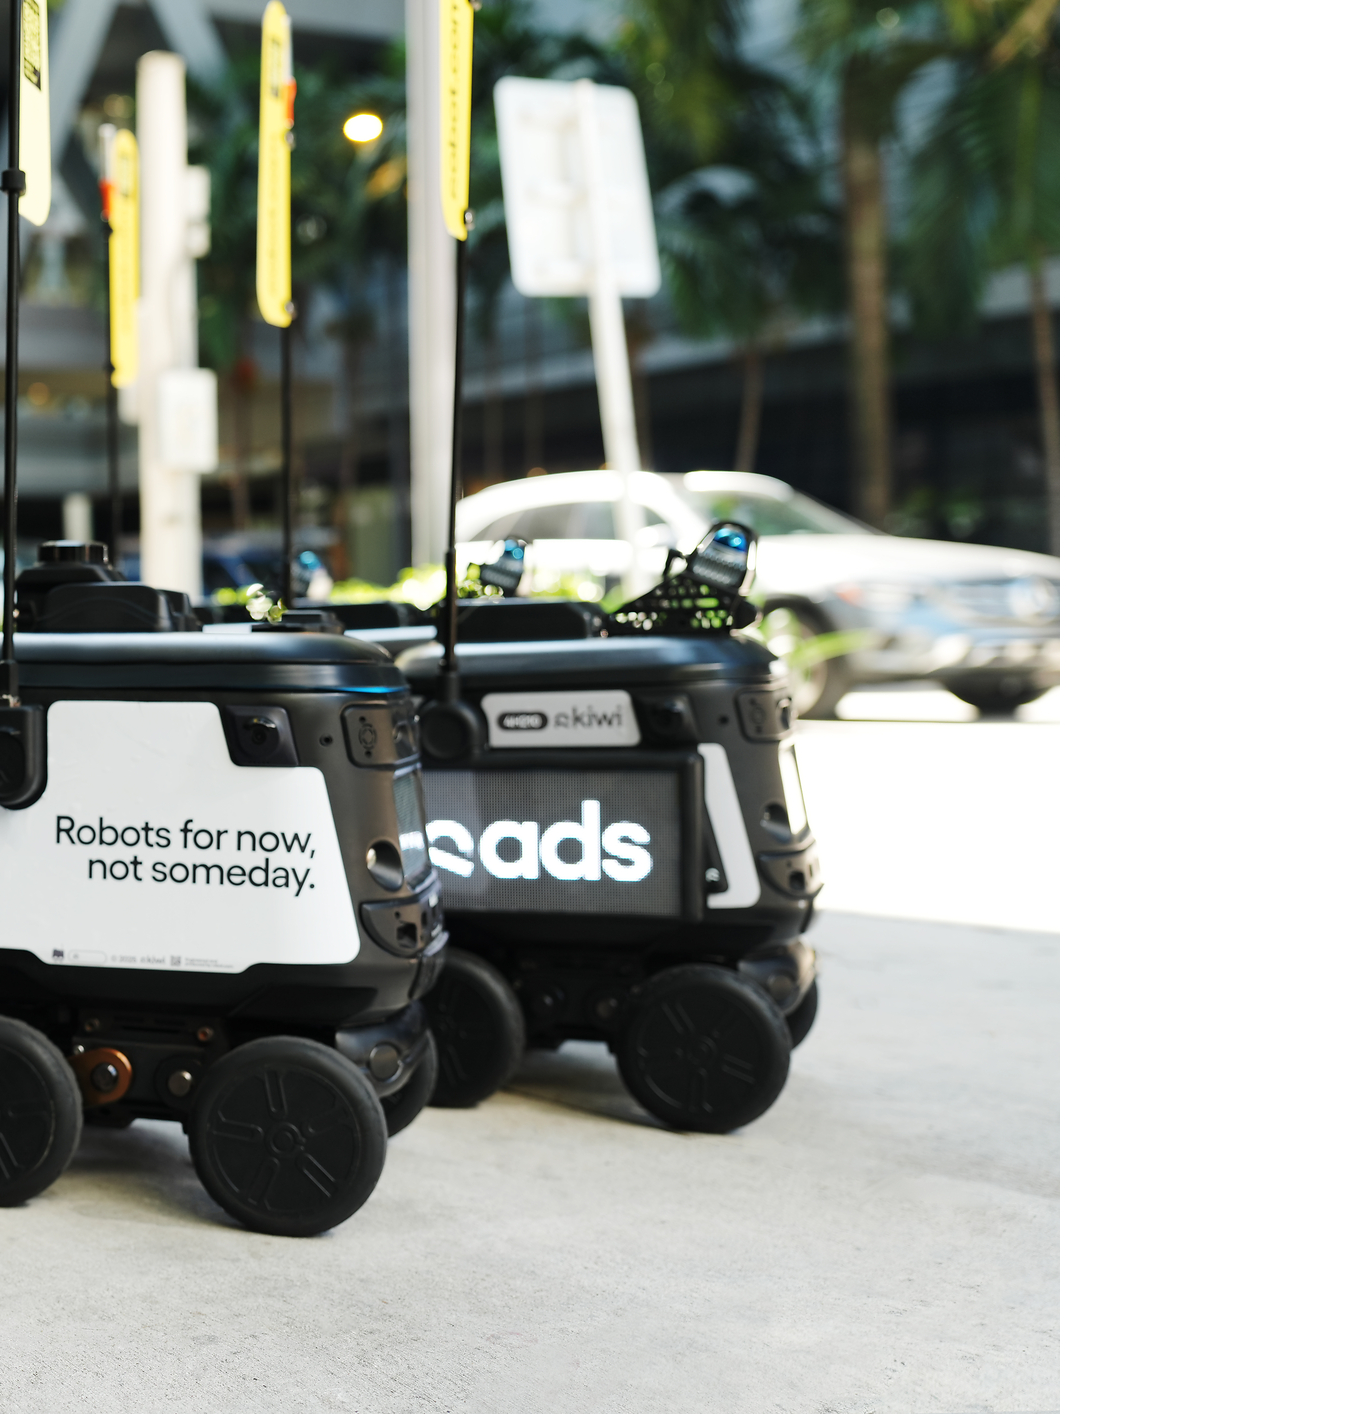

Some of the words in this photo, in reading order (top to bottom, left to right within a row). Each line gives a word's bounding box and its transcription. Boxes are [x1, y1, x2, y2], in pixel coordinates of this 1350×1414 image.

[56, 815, 171, 849] Robots
[179, 818, 229, 851] for
[236, 830, 316, 859] now,
[478, 800, 654, 882] ads
[88, 855, 144, 882] not
[151, 857, 316, 897] someday.
